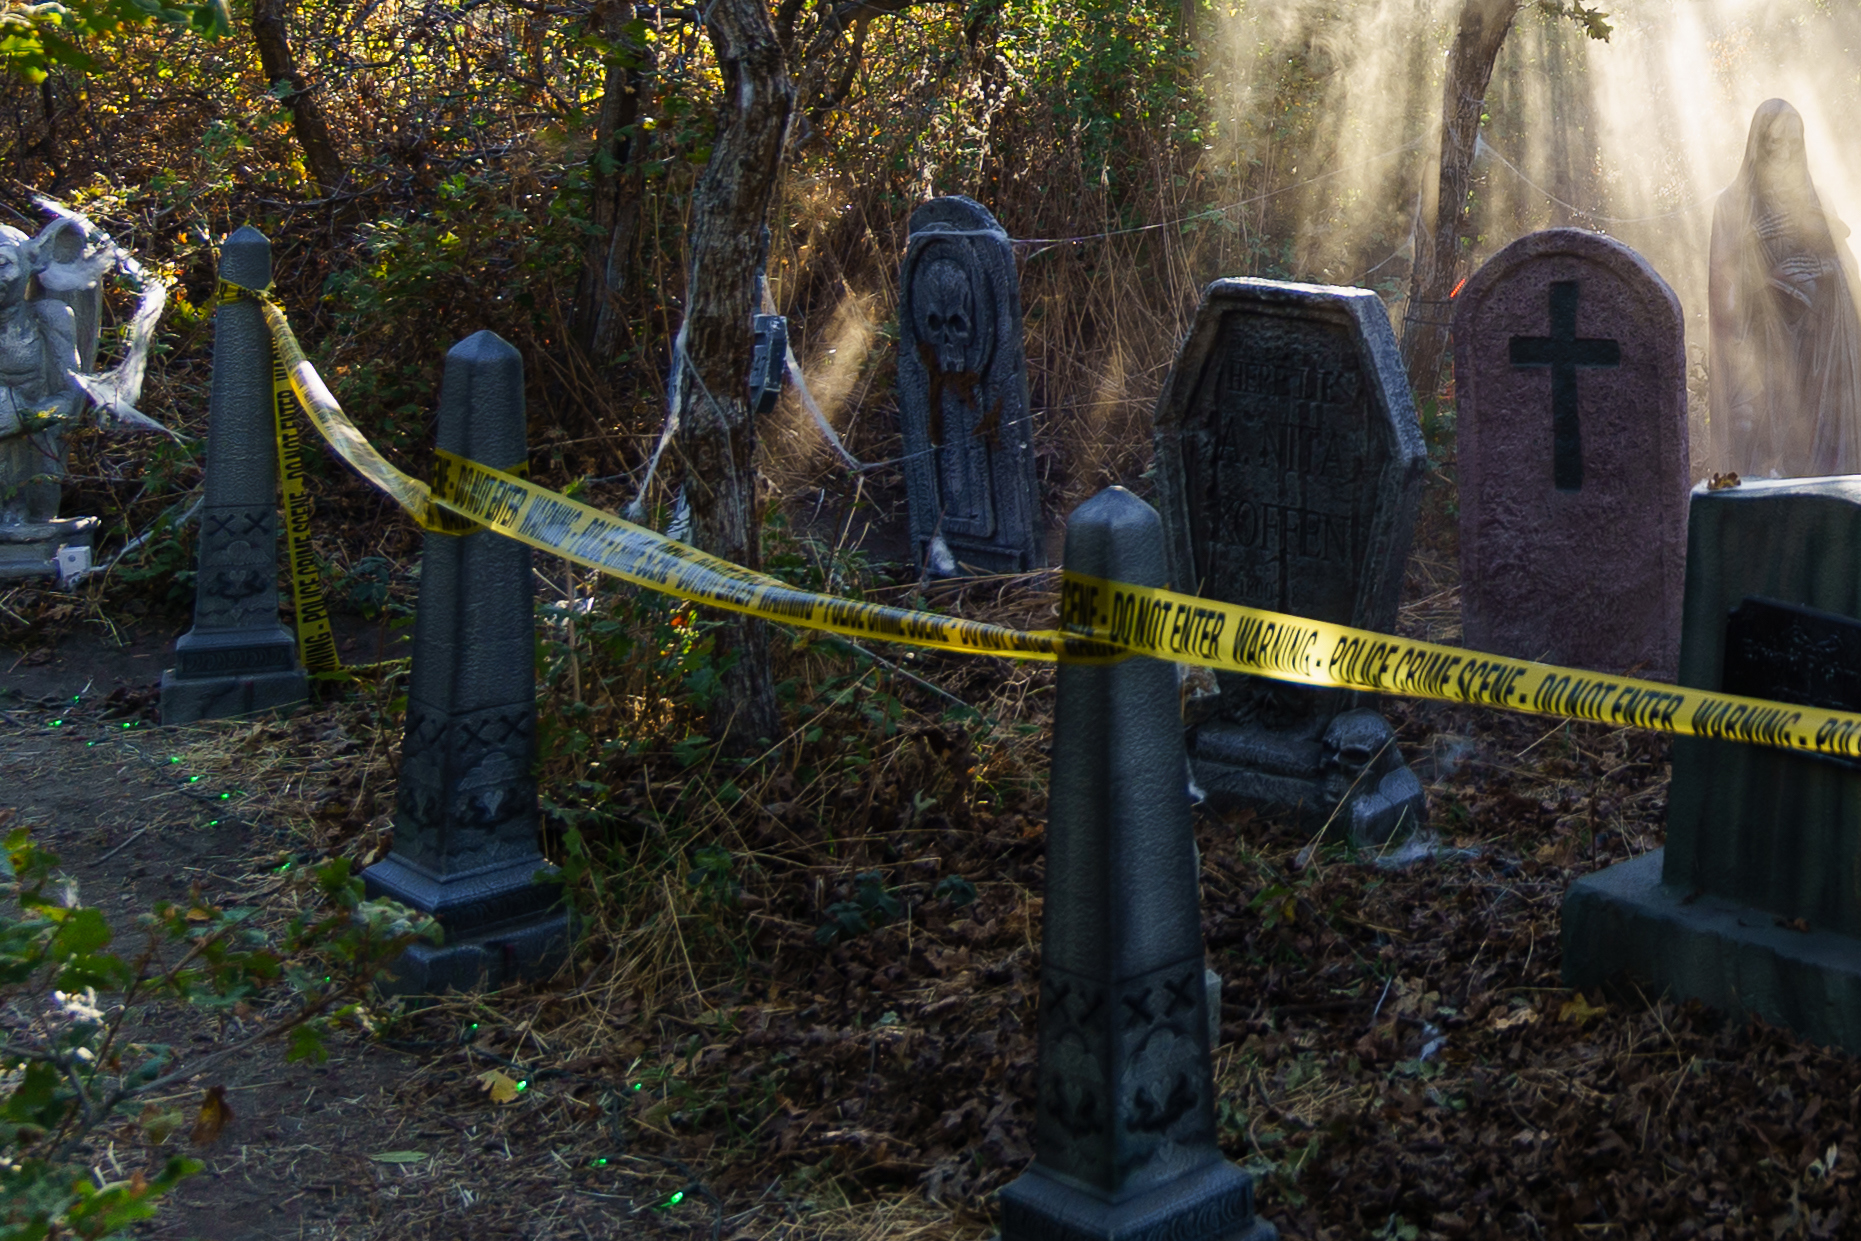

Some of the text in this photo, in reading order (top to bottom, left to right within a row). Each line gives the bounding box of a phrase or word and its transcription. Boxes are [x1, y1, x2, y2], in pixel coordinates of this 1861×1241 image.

[289, 492, 311, 533] SCENE
[484, 479, 528, 528] ENTER
[293, 535, 318, 576] CRIME
[298, 577, 327, 624] POLICE
[1109, 591, 1136, 646] DO
[1133, 596, 1173, 652] NOT
[1170, 603, 1226, 661] ENTER
[1233, 615, 1318, 677] WARNING
[1329, 635, 1400, 690] POLICE
[1393, 648, 1462, 699] CRIME
[1455, 658, 1527, 708] SCENE
[1533, 673, 1571, 715] DO
[1565, 678, 1618, 721] NOT
[1611, 686, 1684, 731] ENTER
[1691, 697, 1802, 748] WARNING
